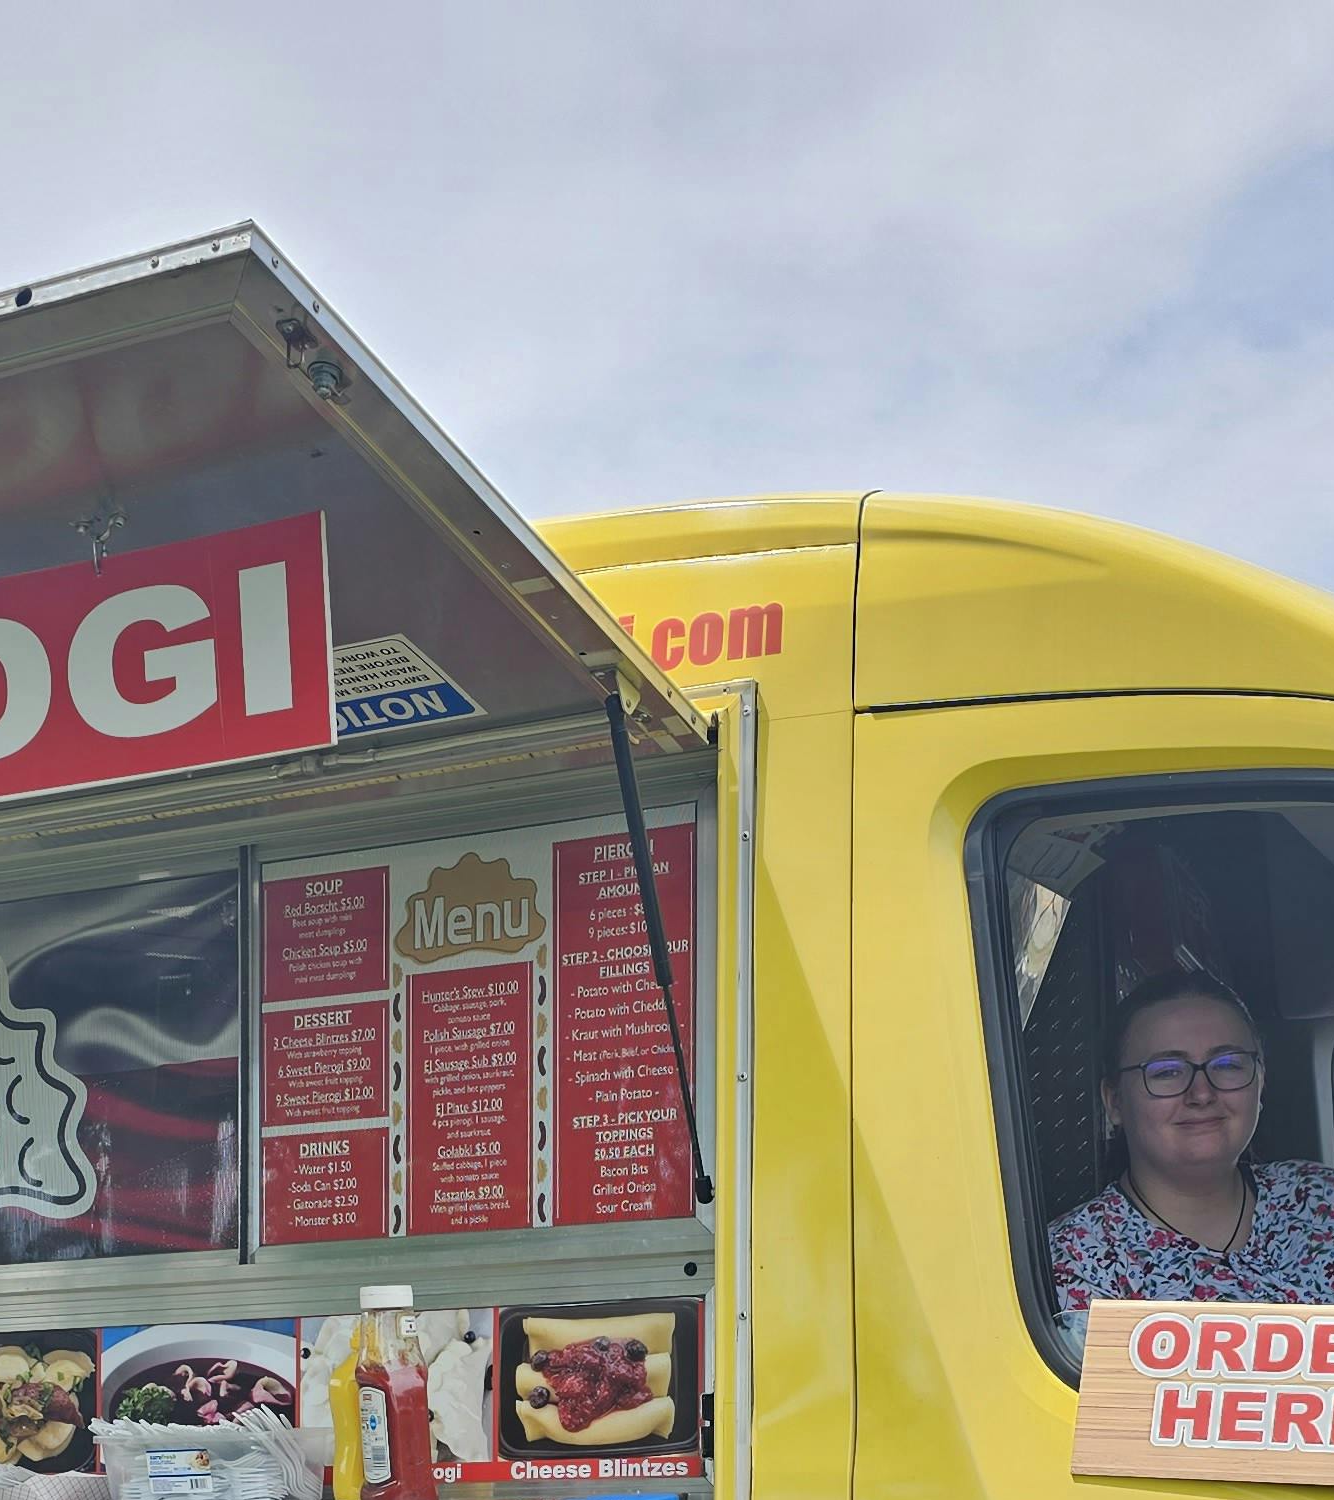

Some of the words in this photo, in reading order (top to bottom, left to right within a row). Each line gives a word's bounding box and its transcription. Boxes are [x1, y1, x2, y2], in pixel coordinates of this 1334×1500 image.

[618, 601, 784, 672] com
[336, 650, 378, 664] WORK
[356, 655, 410, 672] BEFORE
[380, 665, 421, 678] WASH
[354, 674, 430, 694] EMPLOYEES
[337, 690, 448, 731] NOTI
[579, 870, 606, 884] STEP
[653, 862, 669, 873] AN
[306, 879, 343, 896] SOUP
[598, 883, 640, 898] AMOUN
[284, 904, 302, 916] Red
[305, 900, 337, 914] Borscht
[341, 896, 365, 910] $5.00
[590, 909, 595, 920] 6
[598, 907, 626, 921] pieces
[412, 895, 532, 950] Menu
[589, 928, 594, 938] 9
[630, 920, 647, 934] $10
[282, 947, 316, 960] Chicken
[319, 944, 340, 957] Soup
[343, 939, 367, 953] $5.00
[562, 952, 589, 965] STEP
[592, 951, 597, 961] 2
[667, 940, 688, 953] OUR
[600, 961, 650, 977] FILLINGS
[422, 987, 459, 1003] Hunter's
[463, 986, 484, 998] Stew
[488, 980, 518, 995] $10.00
[578, 986, 608, 998] Potato
[611, 981, 632, 993] with
[575, 1008, 605, 1019] Potato
[609, 1004, 629, 1016] with
[633, 998, 667, 1013] Chedda
[294, 1010, 352, 1029] DESSERT
[274, 1038, 278, 1049] 3
[282, 1036, 313, 1048] Cheese
[316, 1033, 349, 1045] Blintzes
[351, 1028, 376, 1041] $7.00
[424, 1029, 449, 1041] Polish
[453, 1027, 486, 1039] Sausage
[489, 1021, 515, 1034] $7.00
[572, 1030, 598, 1041] Kraut
[601, 1027, 621, 1039] with
[626, 1022, 670, 1035] Mushroo
[435, 1059, 469, 1071] Sausage
[472, 1055, 488, 1067] Sub
[491, 1052, 517, 1066] $9.00
[574, 1051, 597, 1061] Meat
[278, 1066, 283, 1077] 6
[287, 1065, 312, 1076] Sweet
[315, 1061, 344, 1074] Pierogi
[347, 1057, 371, 1071] $9.00
[575, 1069, 610, 1086] Spinach
[614, 1067, 634, 1080] with
[638, 1065, 673, 1077] Cheese
[276, 1095, 281, 1106] 9
[284, 1094, 309, 1104] Sweet
[313, 1091, 341, 1103] Pierogi
[344, 1086, 373, 1100] $12.00
[596, 1090, 617, 1102] Plain
[620, 1087, 652, 1100] Potato
[447, 1101, 468, 1114] Plate
[472, 1098, 503, 1113] $12.00
[573, 1116, 599, 1128] STEP
[603, 1115, 608, 1125] 3
[618, 1110, 645, 1123] PICK
[646, 1108, 677, 1121] YOUR
[596, 1127, 653, 1142] TOPPINGS
[299, 1140, 350, 1156] DRINKS
[475, 1141, 500, 1155] $5.00
[594, 1147, 620, 1160] $0.50
[623, 1144, 654, 1157] EACH
[327, 1161, 351, 1174] $1.50
[600, 1165, 628, 1177] Bacon
[632, 1163, 648, 1175] Bits
[314, 1180, 330, 1191] Can
[333, 1177, 357, 1190] $2.00
[593, 1182, 624, 1196] Grilled
[627, 1181, 656, 1193] Onion
[294, 1197, 332, 1210] Gatorade
[335, 1194, 358, 1207] $2.50
[434, 1188, 474, 1202] Kaszanka
[478, 1185, 503, 1199] $9.00
[596, 1202, 617, 1214] Sour
[621, 1200, 652, 1212] Cream
[295, 1216, 330, 1226] Monster
[332, 1212, 356, 1225] $3.00
[510, 1460, 591, 1480] Cheese
[598, 1457, 689, 1479] Blintzes
